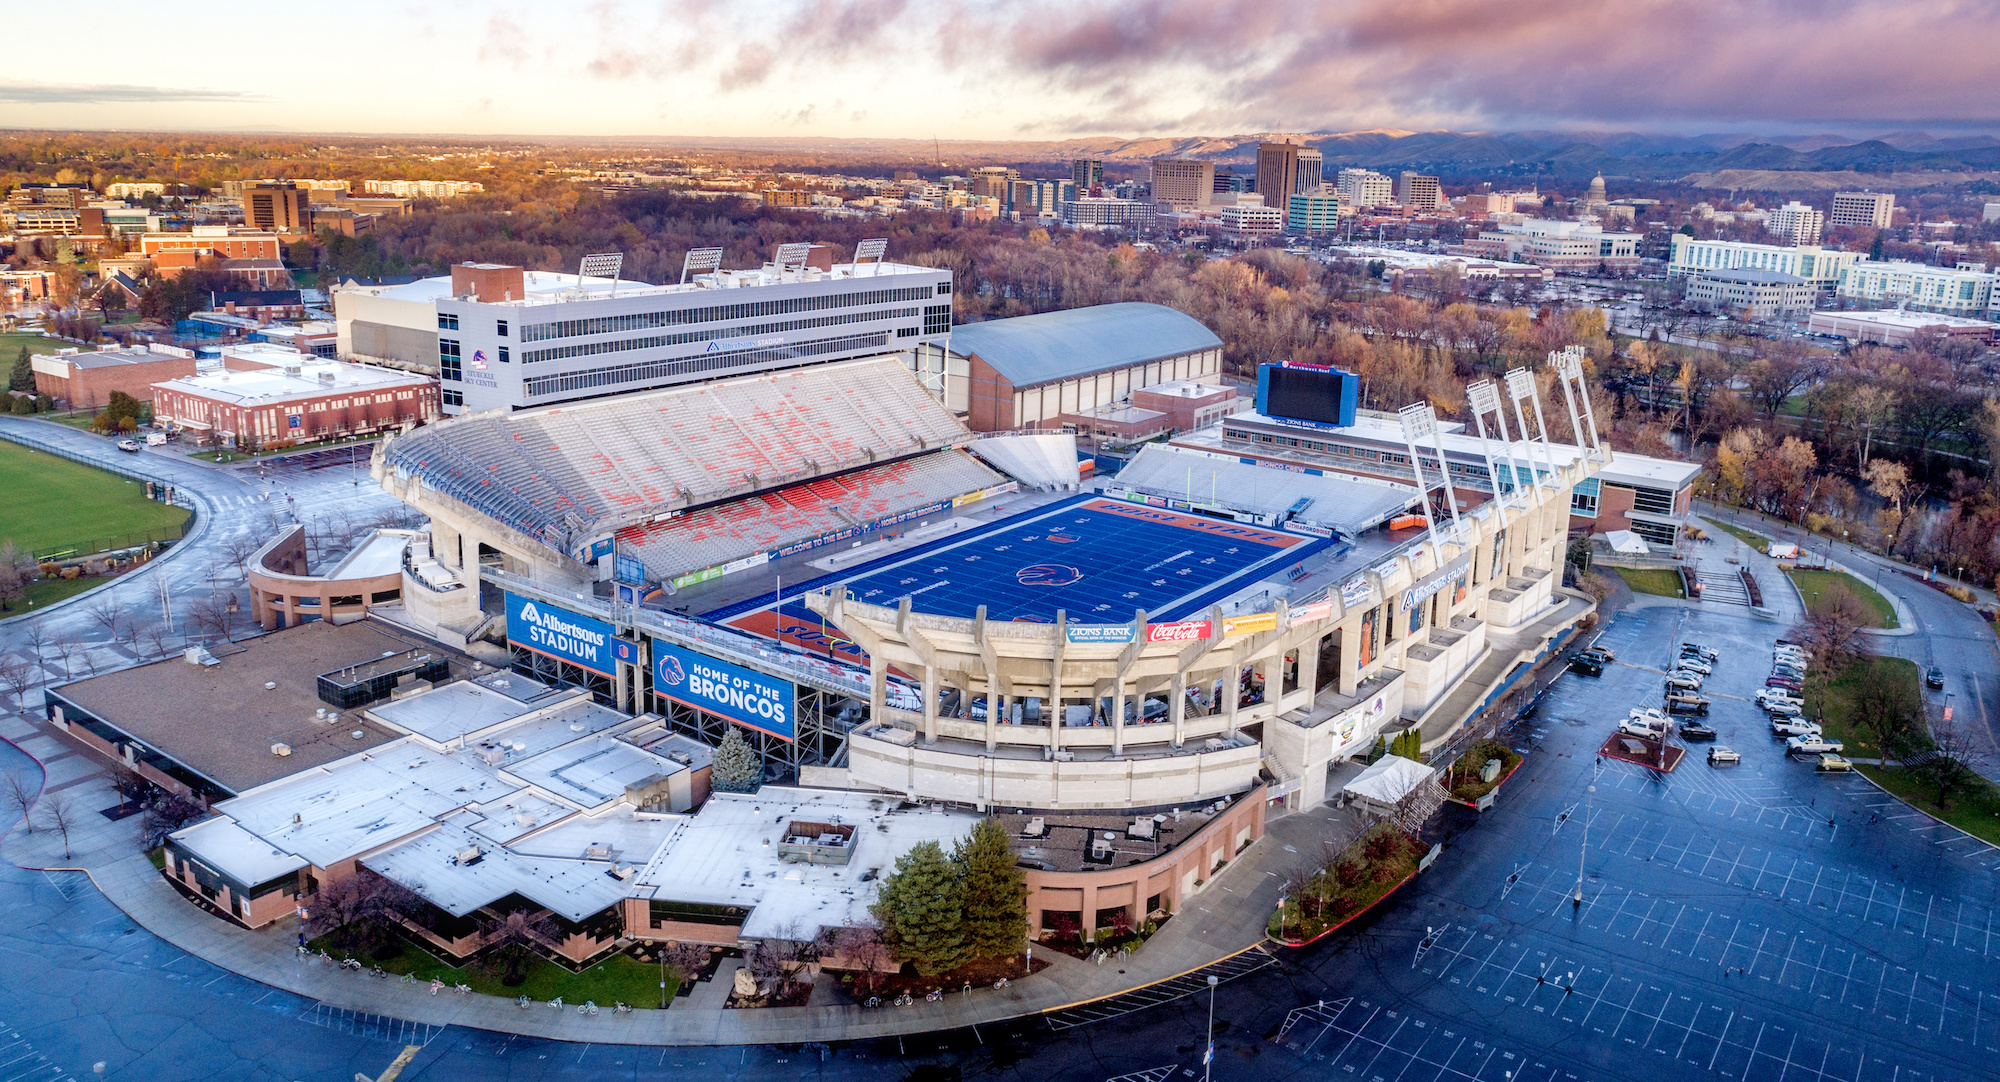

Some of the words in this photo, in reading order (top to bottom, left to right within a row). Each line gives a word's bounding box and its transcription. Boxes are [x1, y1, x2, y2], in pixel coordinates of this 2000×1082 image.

[757, 337, 784, 346] STADIUM
[464, 377, 475, 385] SKY
[476, 379, 498, 388] CENTER
[467, 370, 494, 380] STUECKLE
[1256, 460, 1283, 470] BRONCO
[1285, 465, 1305, 474] CREW
[1189, 522, 1287, 542] STATE
[779, 540, 813, 557] WELCOME
[813, 538, 822, 546] TO
[823, 534, 836, 545] THE
[836, 529, 852, 541] BLUE
[1447, 561, 1470, 584] STADIUM
[543, 613, 604, 646] Albertsons
[1070, 627, 1101, 636] ZIONS
[1103, 627, 1132, 636] BANK
[530, 625, 597, 662] STADIUM
[694, 663, 729, 684] HOME
[733, 677, 750, 690] OF
[754, 683, 780, 701] THE
[689, 674, 786, 723] BRONCOS
